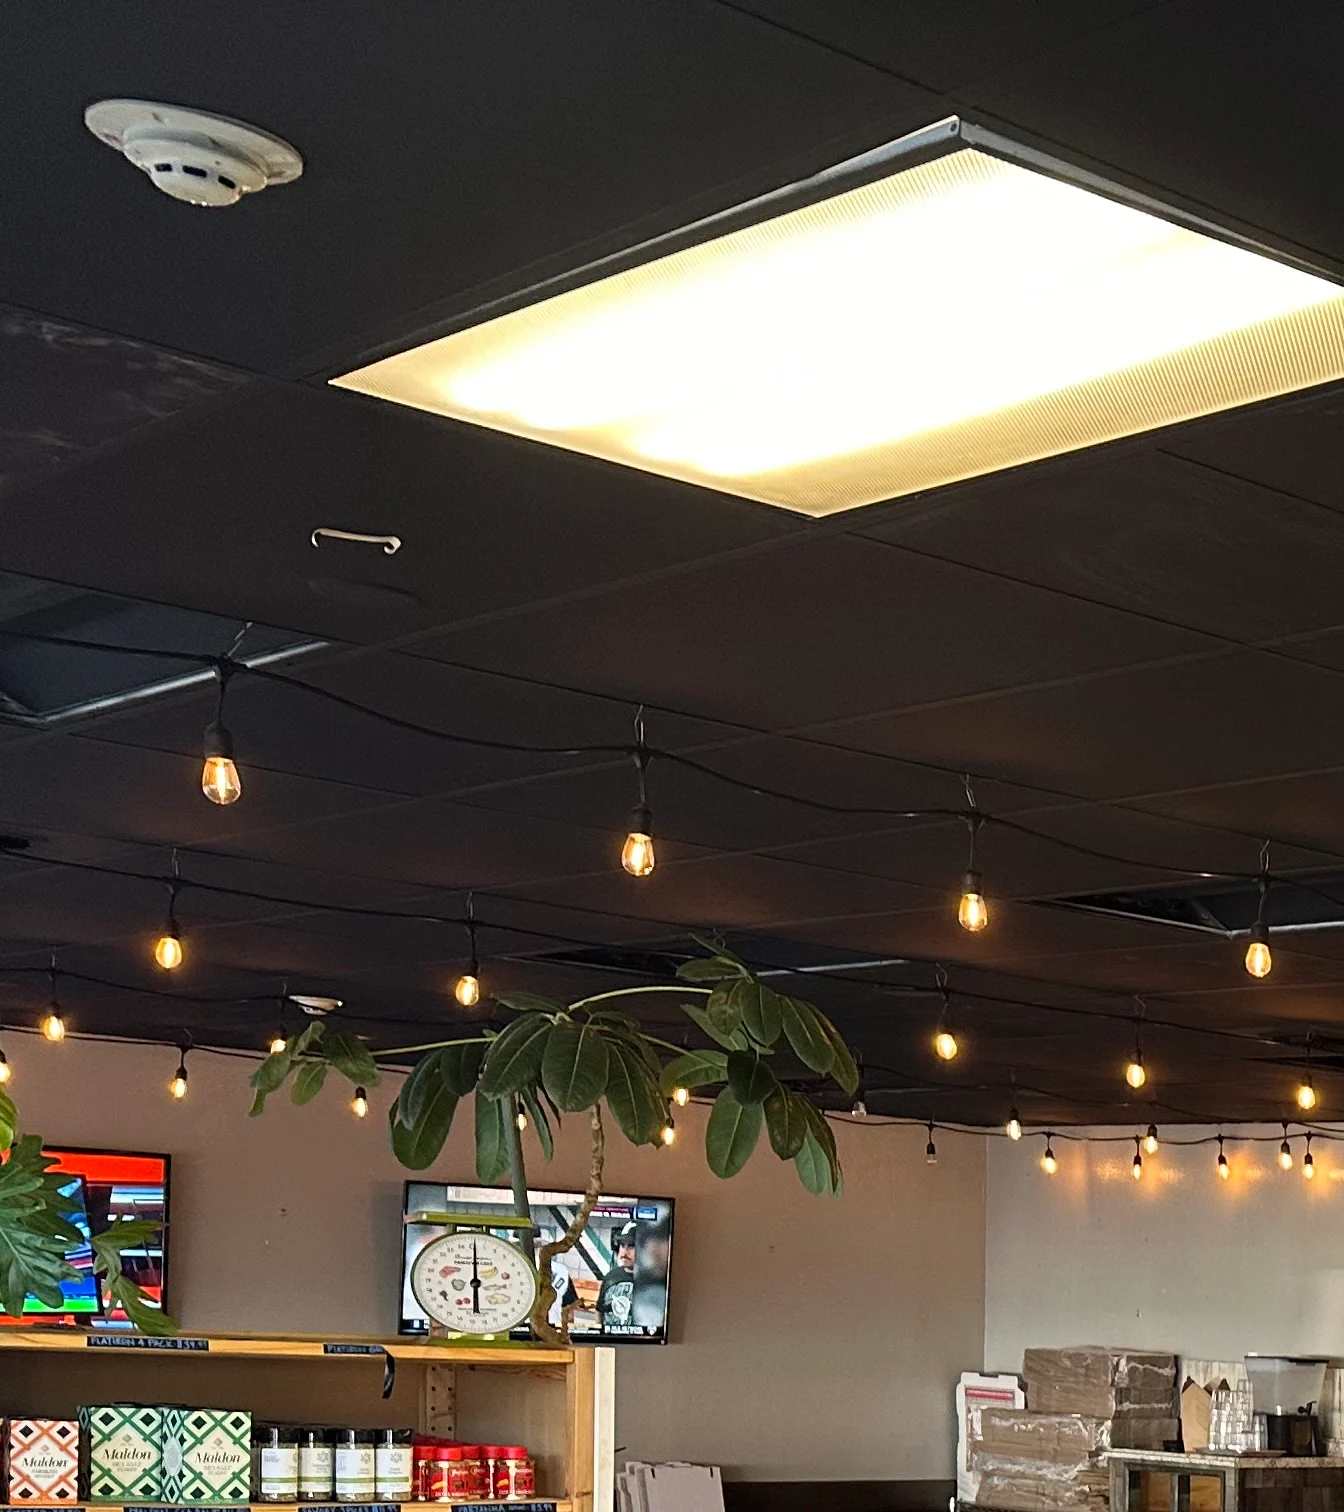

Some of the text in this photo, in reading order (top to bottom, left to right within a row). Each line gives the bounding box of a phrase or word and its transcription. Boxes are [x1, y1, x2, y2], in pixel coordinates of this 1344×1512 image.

[102, 1446, 152, 1460] Maldon
[195, 1452, 241, 1464] Maldon
[23, 1457, 68, 1468] Maldon
